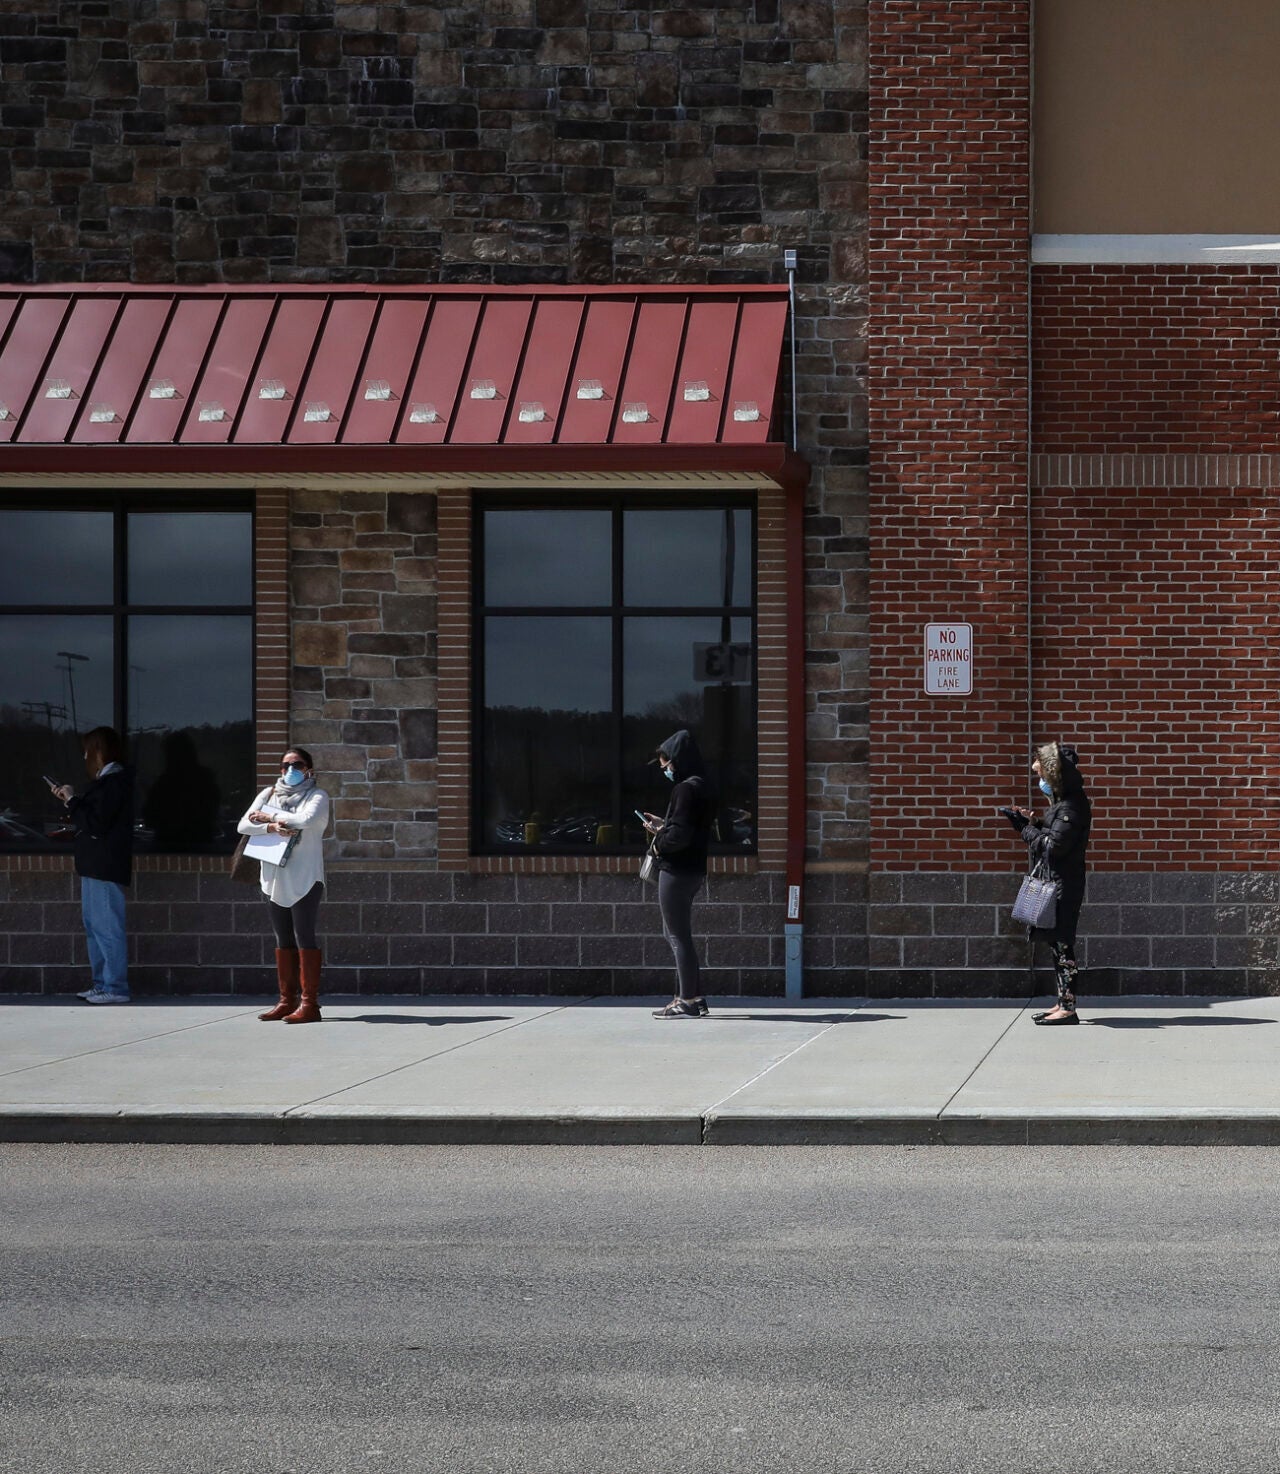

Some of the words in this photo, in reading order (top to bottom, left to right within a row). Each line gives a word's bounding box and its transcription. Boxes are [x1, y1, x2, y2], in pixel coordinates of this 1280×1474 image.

[939, 631, 956, 643] NO
[928, 649, 969, 662] PARKING
[938, 666, 958, 676] FIRE
[937, 678, 960, 688] LANE
